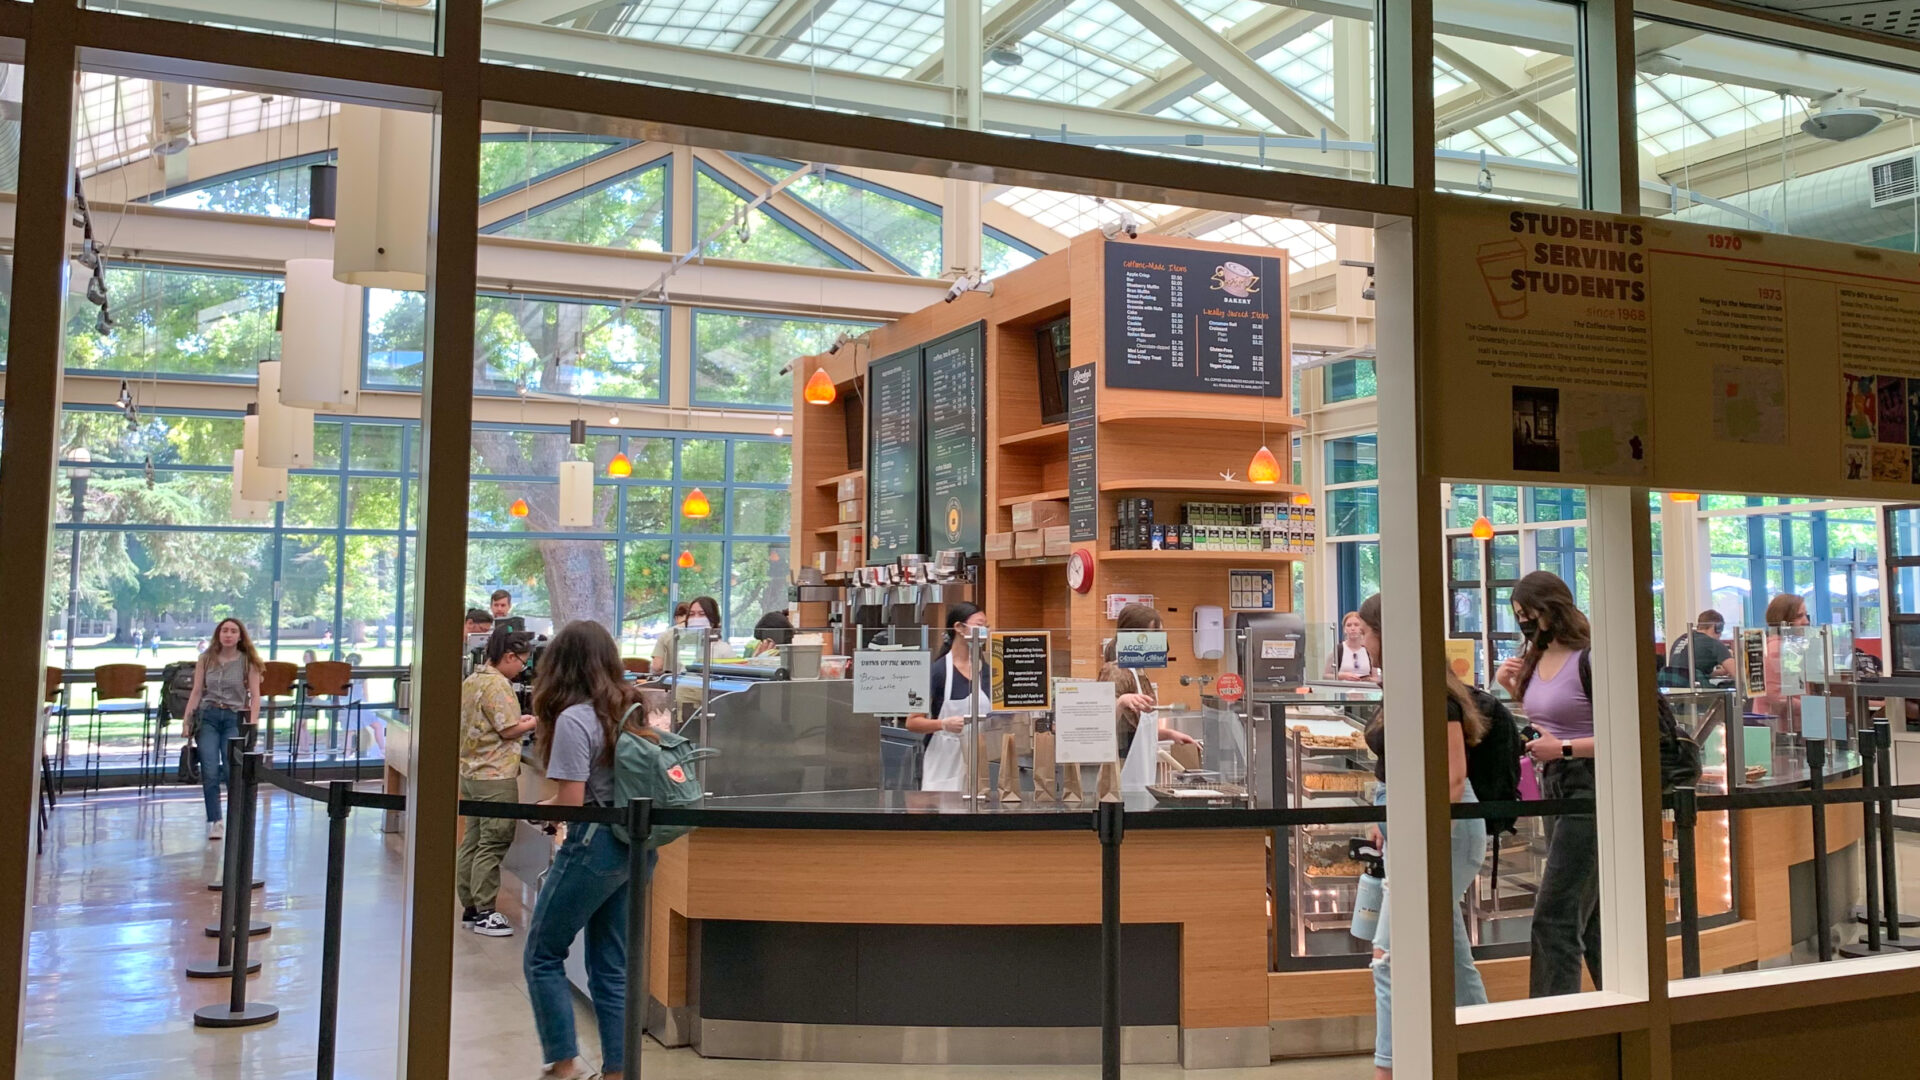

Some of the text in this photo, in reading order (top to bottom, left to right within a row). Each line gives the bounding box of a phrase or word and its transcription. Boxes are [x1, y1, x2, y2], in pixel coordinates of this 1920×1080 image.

[1510, 211, 1643, 246] STUDENTS
[1708, 234, 1742, 250] 1970
[1534, 242, 1643, 273] SERVING
[1511, 270, 1645, 302] STUDENTS
[1758, 288, 1782, 300] 1973
[1699, 297, 1721, 306] Moving
[1585, 308, 1645, 321] since 1968
[1586, 321, 1605, 330] Coffee
